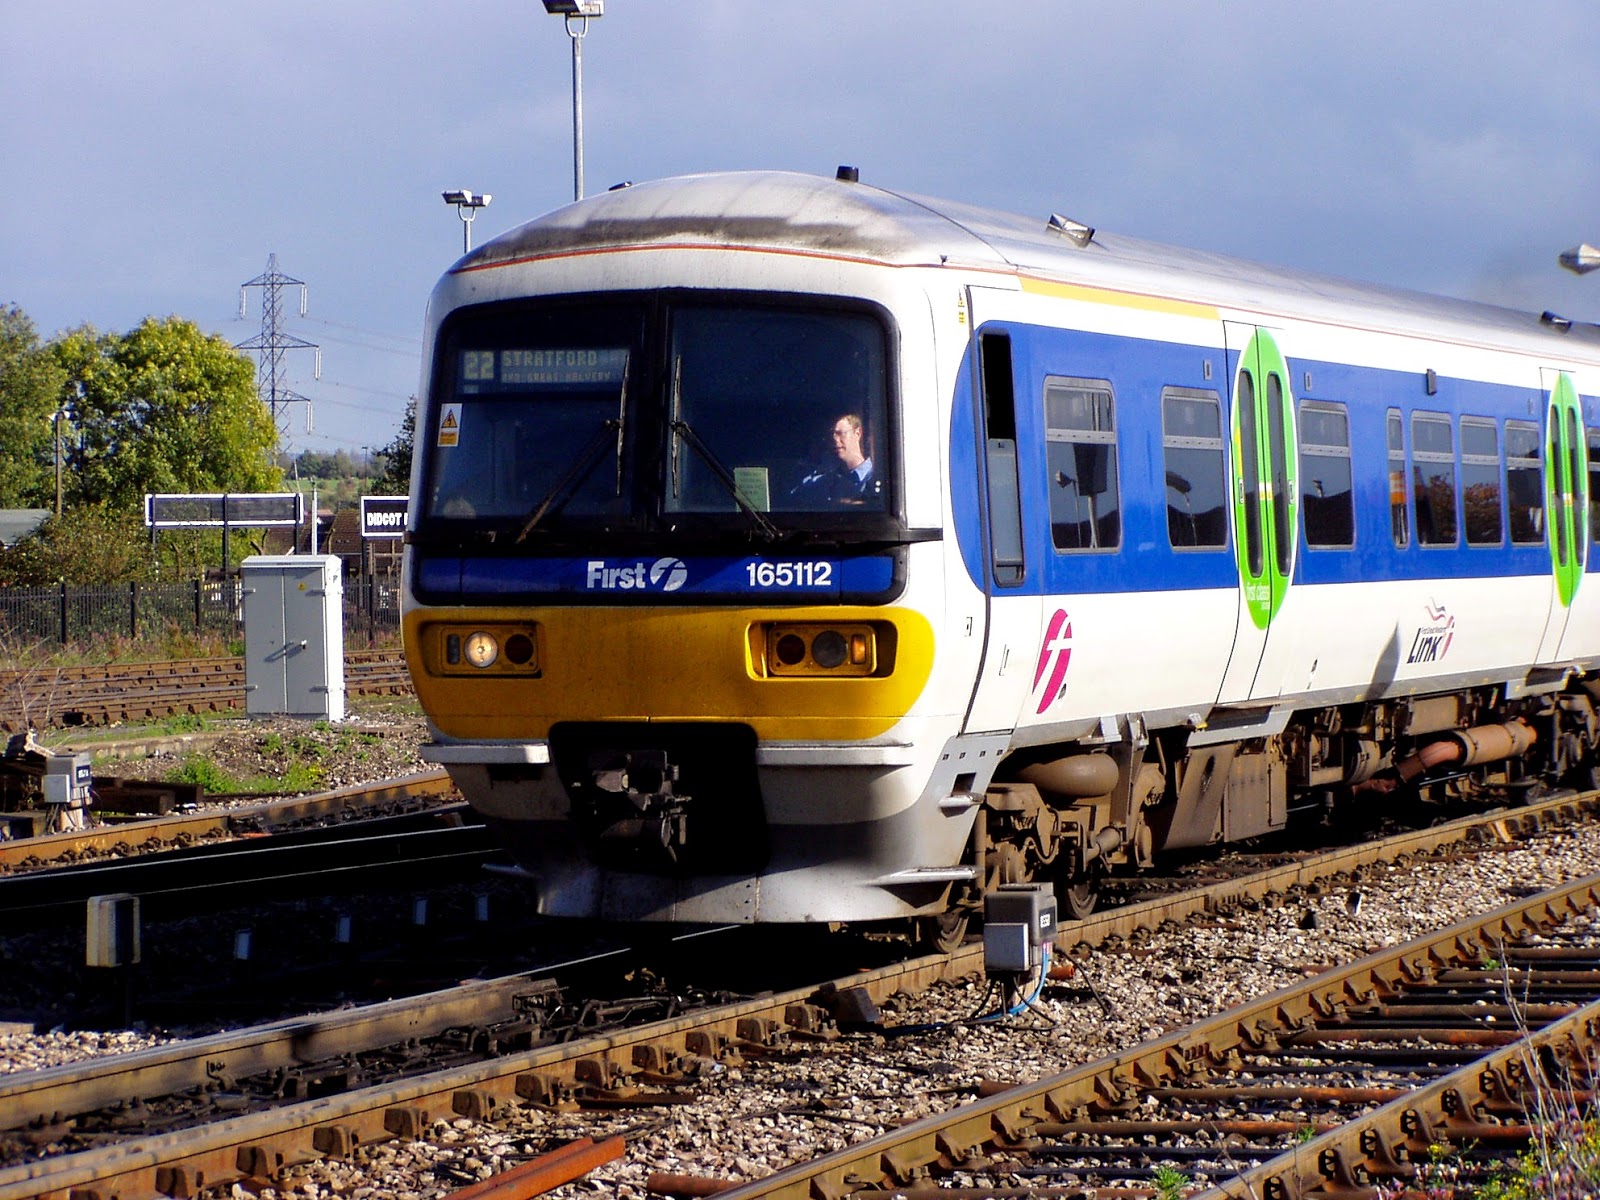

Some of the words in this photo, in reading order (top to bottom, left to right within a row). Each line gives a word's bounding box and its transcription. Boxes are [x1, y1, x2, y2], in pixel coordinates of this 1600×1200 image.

[463, 350, 494, 379] 22
[502, 350, 597, 367] STRATFORD
[366, 512, 402, 526] DIDCOT
[587, 560, 646, 589] First
[747, 562, 832, 586] 165112
